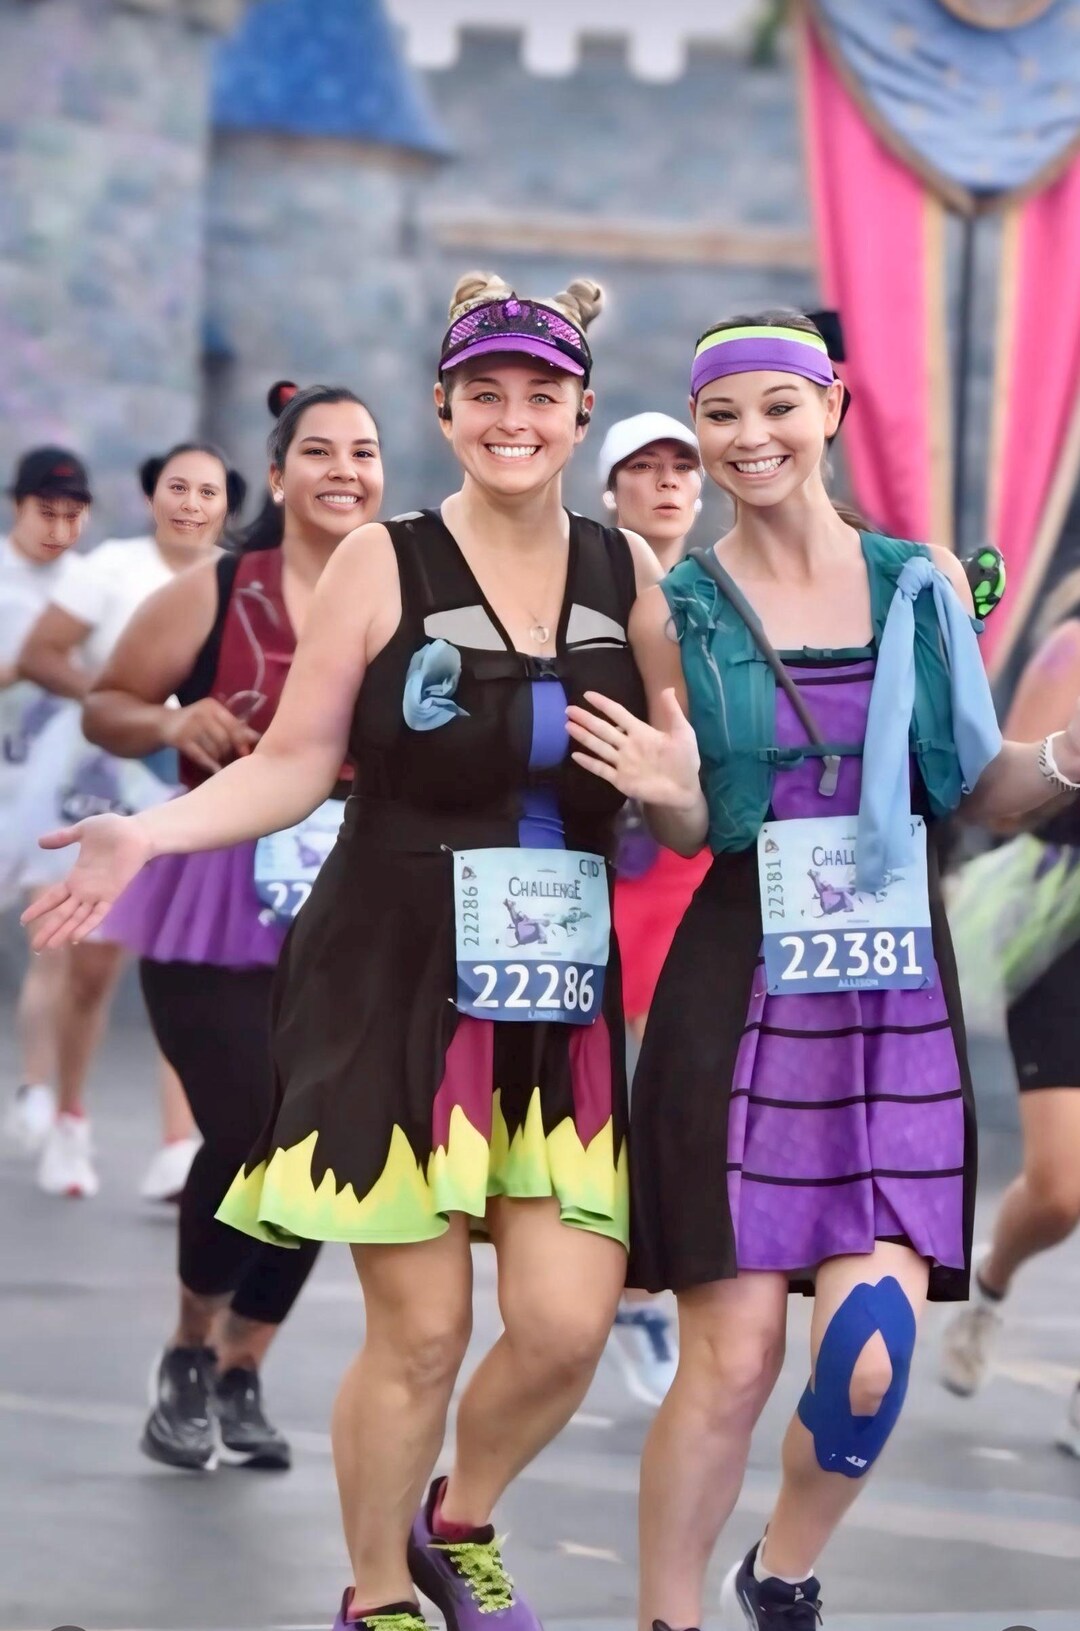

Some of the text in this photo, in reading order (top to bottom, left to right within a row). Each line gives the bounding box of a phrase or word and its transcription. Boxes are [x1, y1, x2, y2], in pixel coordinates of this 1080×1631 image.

[812, 846, 856, 867] CHALL
[508, 876, 582, 900] CHALLENGE
[765, 859, 786, 919] 22381
[462, 886, 479, 947] 22286
[779, 931, 923, 980] 22381
[472, 964, 594, 1012] 22286
